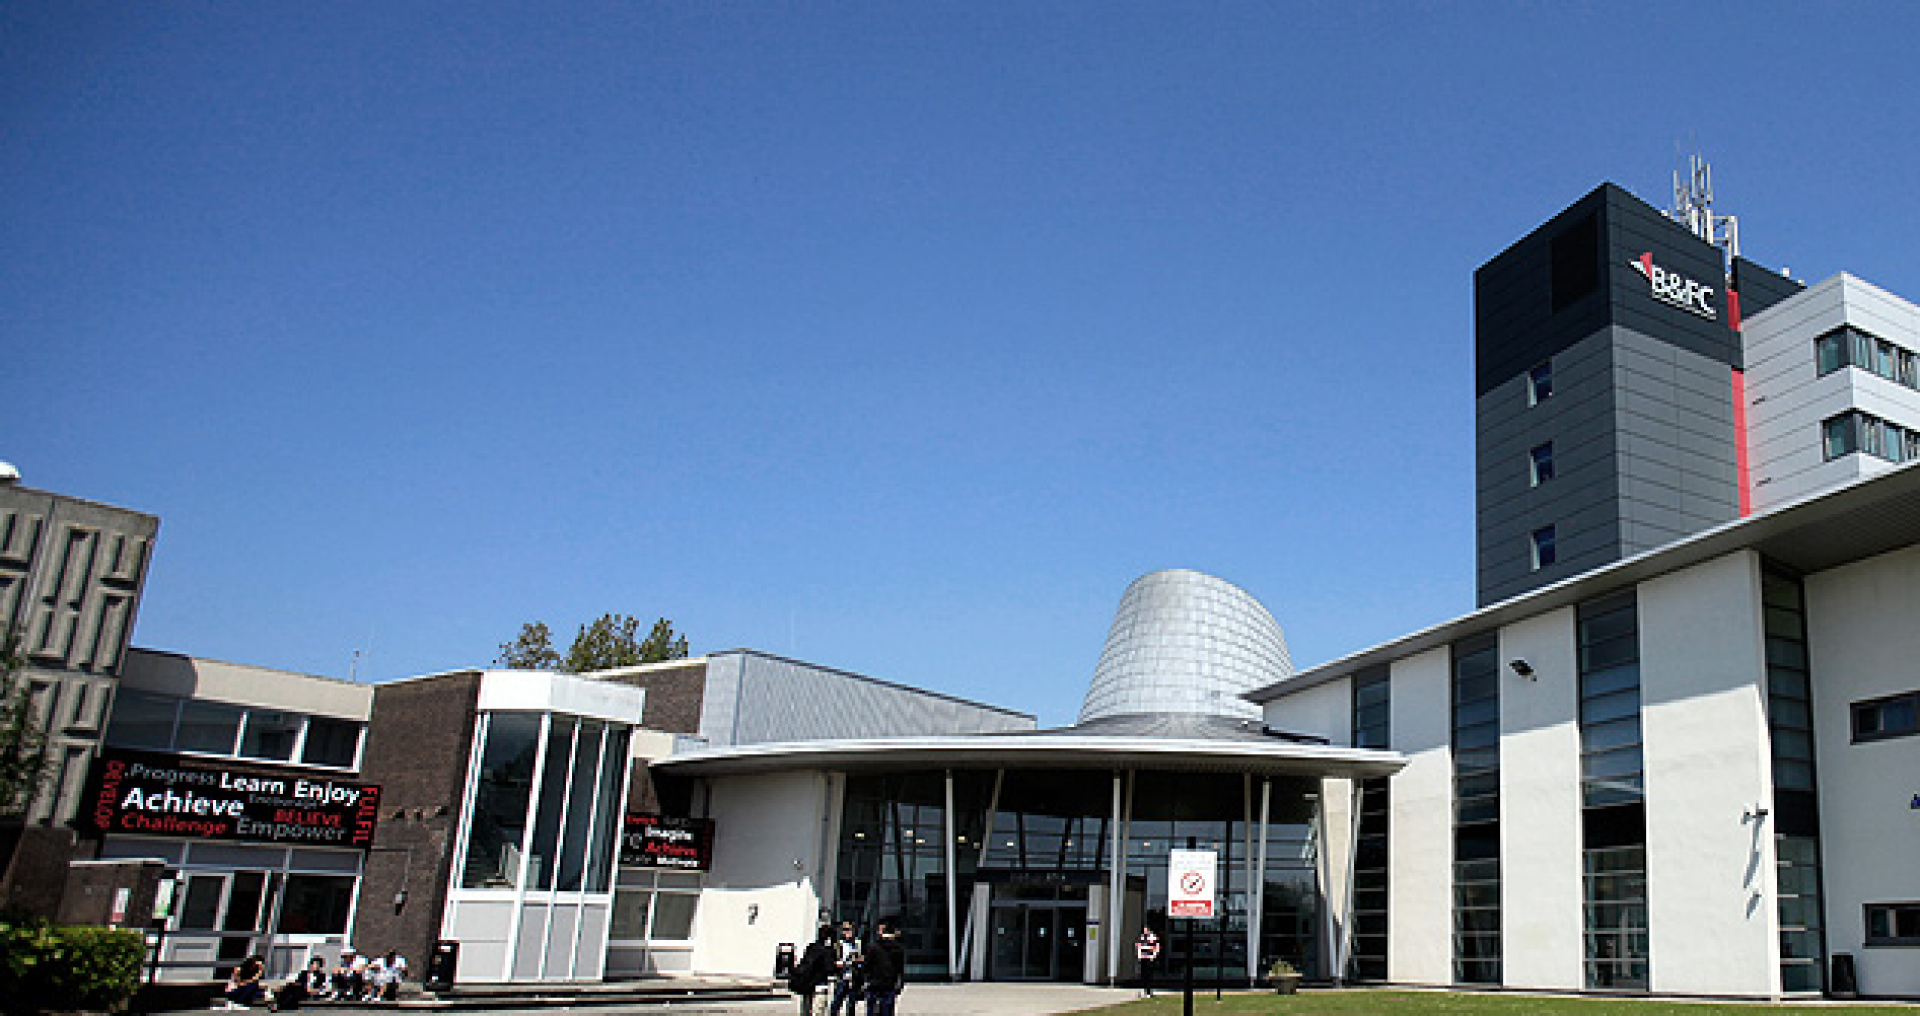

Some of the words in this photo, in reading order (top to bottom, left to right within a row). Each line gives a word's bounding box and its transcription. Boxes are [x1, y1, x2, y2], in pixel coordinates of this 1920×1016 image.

[1652, 265, 1715, 313] B&FC
[121, 787, 245, 816] Achieve
[219, 772, 284, 794] Learn
[294, 778, 360, 806] Enjoy
[121, 811, 228, 838] Challenge
[236, 816, 346, 840] Empower
[353, 786, 378, 844] FULFIL
